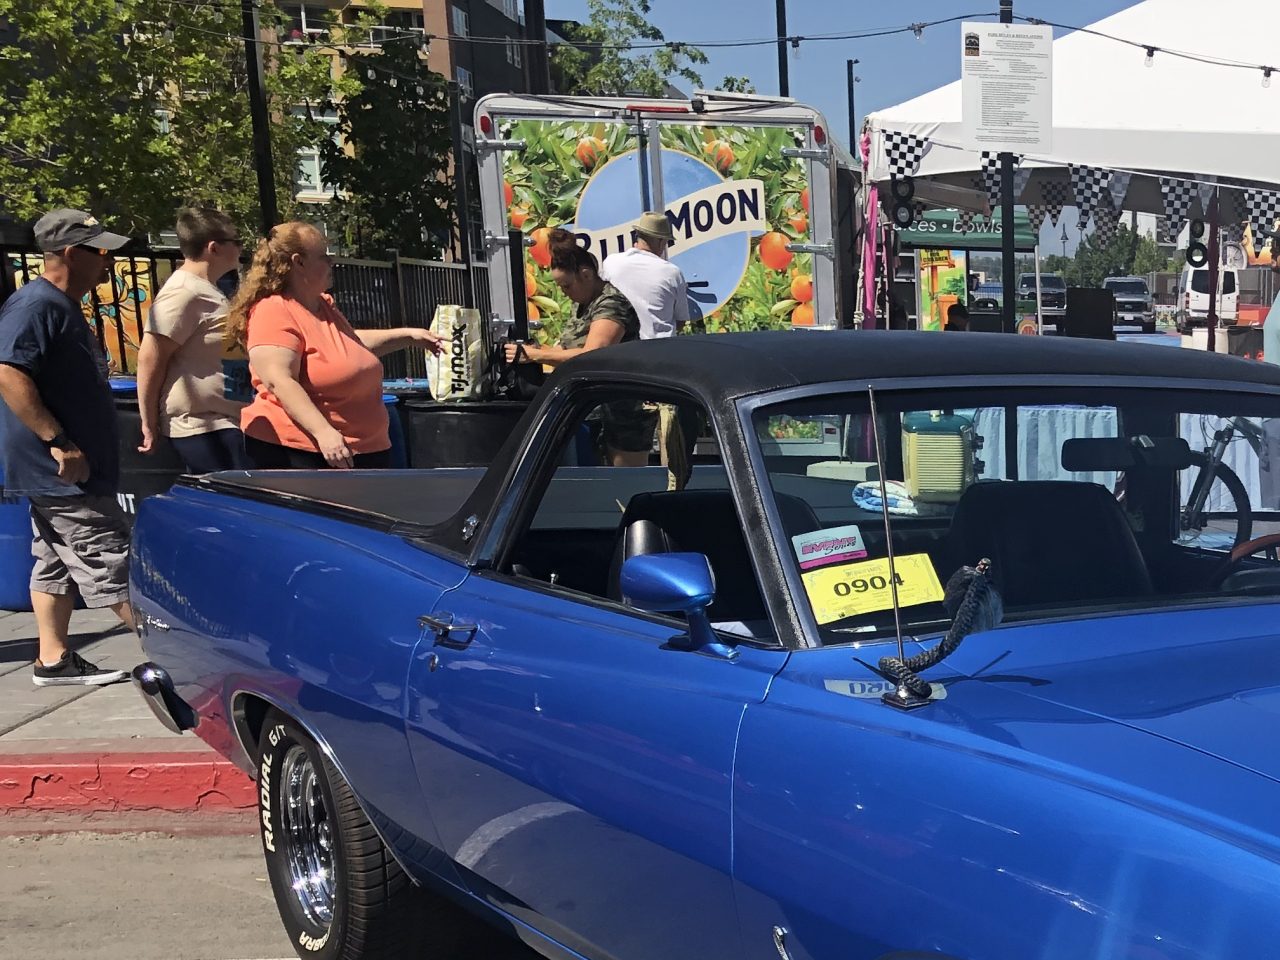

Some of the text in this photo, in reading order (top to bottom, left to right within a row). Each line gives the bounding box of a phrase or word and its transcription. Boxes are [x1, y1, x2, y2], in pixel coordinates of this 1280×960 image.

[664, 187, 760, 248] MOON
[833, 572, 905, 597] 0904
[260, 752, 277, 852] RADIAL
